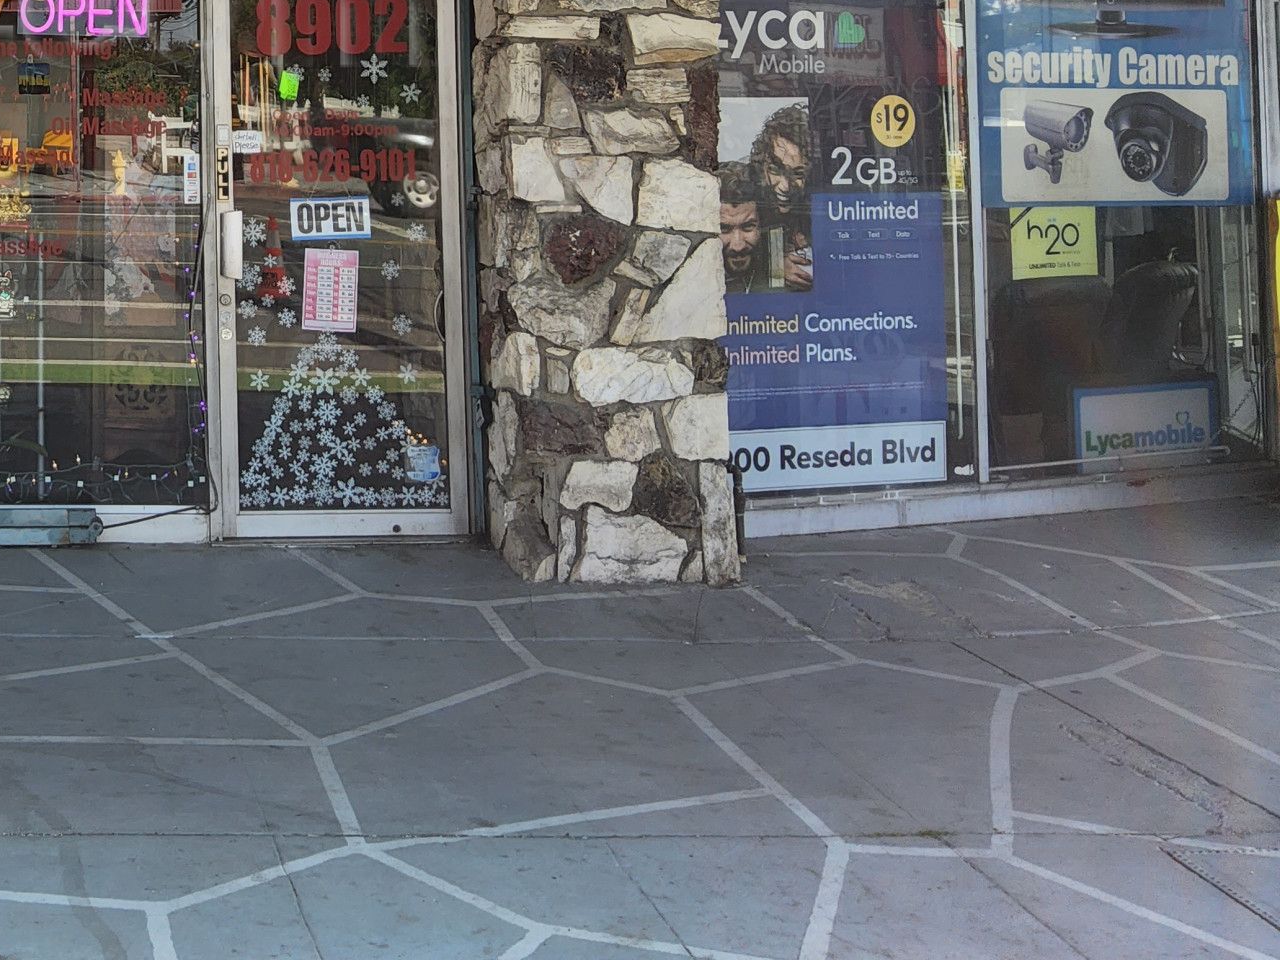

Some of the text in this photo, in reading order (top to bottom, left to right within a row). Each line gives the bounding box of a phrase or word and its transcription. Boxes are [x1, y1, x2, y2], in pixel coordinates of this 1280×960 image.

[718, 10, 825, 59] yca
[759, 54, 825, 74] Mobile
[987, 46, 1239, 88] security Camera
[876, 103, 910, 132] $19
[217, 148, 229, 200] PULL
[249, 148, 417, 183] 818-626-9101
[296, 201, 365, 234] OPEN
[828, 200, 919, 221] Unlimited
[726, 312, 918, 336] nlimited Connections.
[806, 343, 857, 363] Plans.
[780, 441, 873, 470] Reseda
[882, 438, 936, 465] Blvd
[1085, 422, 1205, 456] Lycamobile
